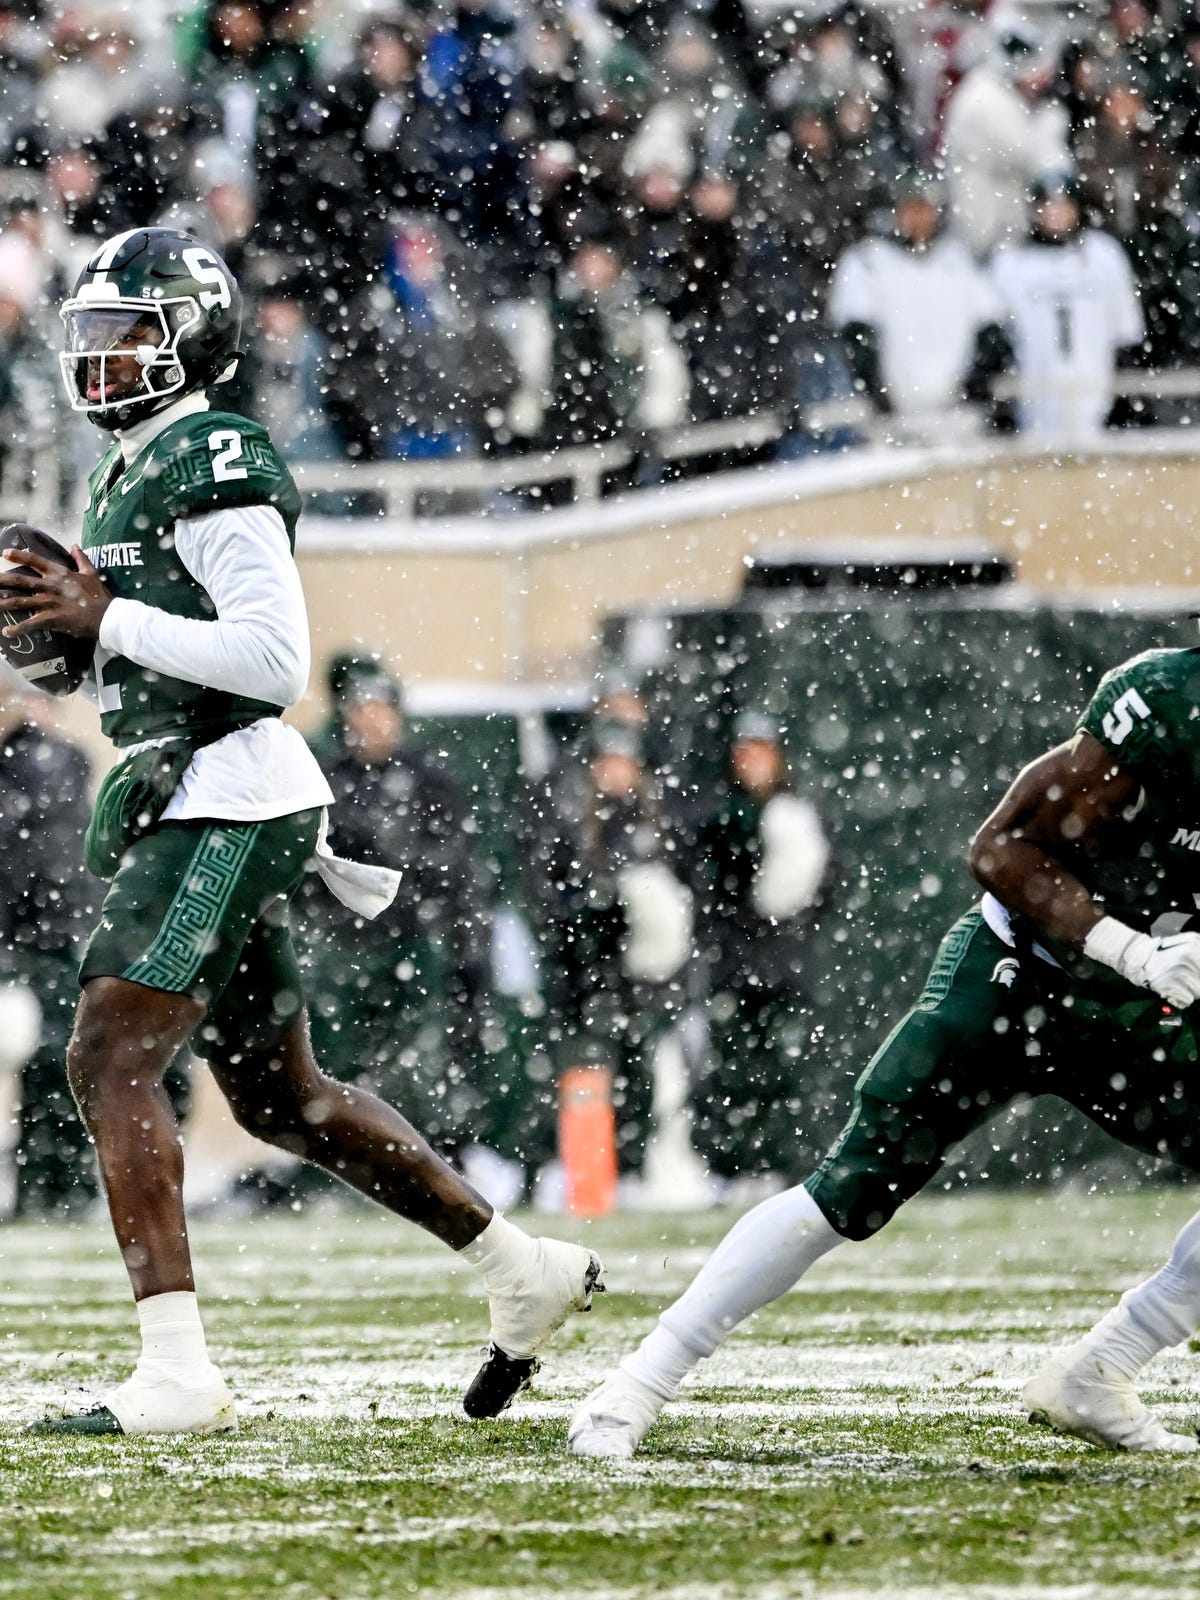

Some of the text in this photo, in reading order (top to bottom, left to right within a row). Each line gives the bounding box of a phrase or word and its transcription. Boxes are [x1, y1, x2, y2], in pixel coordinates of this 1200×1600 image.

[181, 247, 232, 311] S
[209, 430, 248, 483] 2
[100, 542, 144, 569] STATE
[1102, 687, 1151, 745] 5
